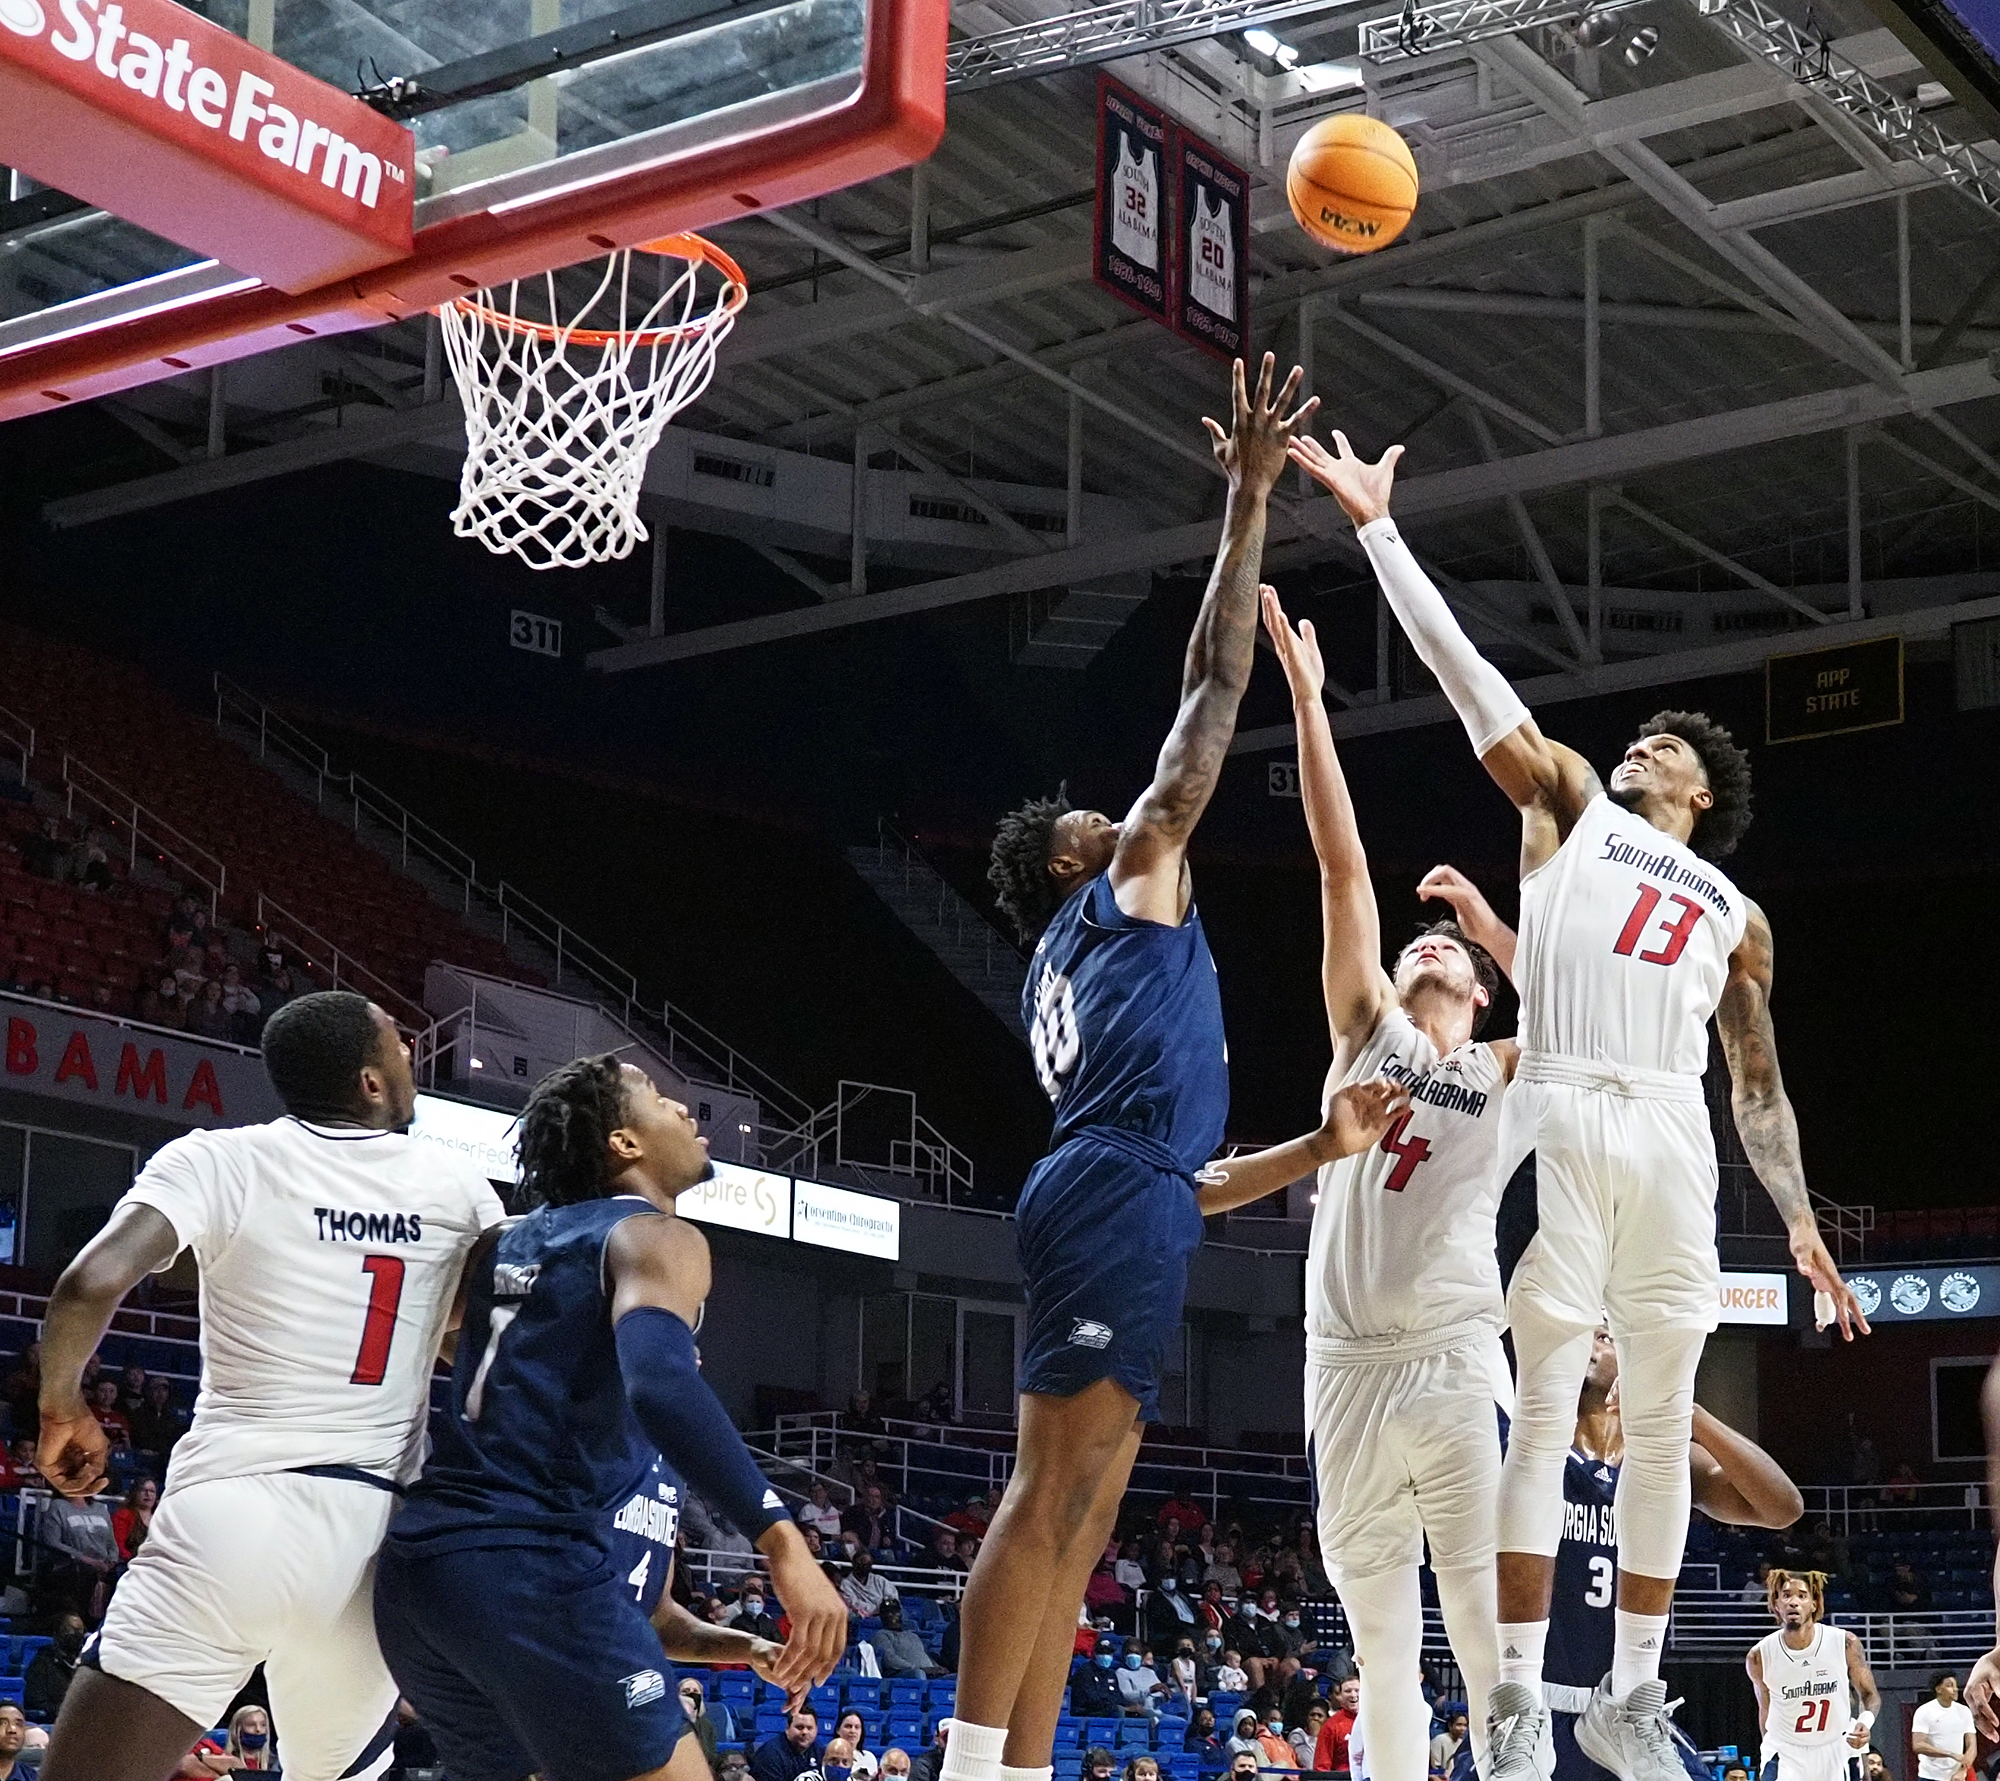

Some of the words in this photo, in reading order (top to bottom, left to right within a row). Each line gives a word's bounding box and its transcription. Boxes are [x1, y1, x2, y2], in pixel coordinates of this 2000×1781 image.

[1123, 165, 1149, 192] SOUTH
[1125, 185, 1146, 218] 32
[1202, 236, 1224, 270] 20
[513, 616, 560, 653] 311
[1817, 668, 1850, 689] APP
[1806, 688, 1861, 714] STATE
[1612, 881, 1706, 967] 13
[6, 1016, 224, 1116] BAMA
[1380, 1108, 1433, 1193] 4
[314, 1207, 421, 1243] THOMAS
[350, 1255, 406, 1386] 1
[628, 1550, 651, 1602] 4
[1584, 1556, 1614, 1608] 3
[1795, 1699, 1831, 1733] 21
